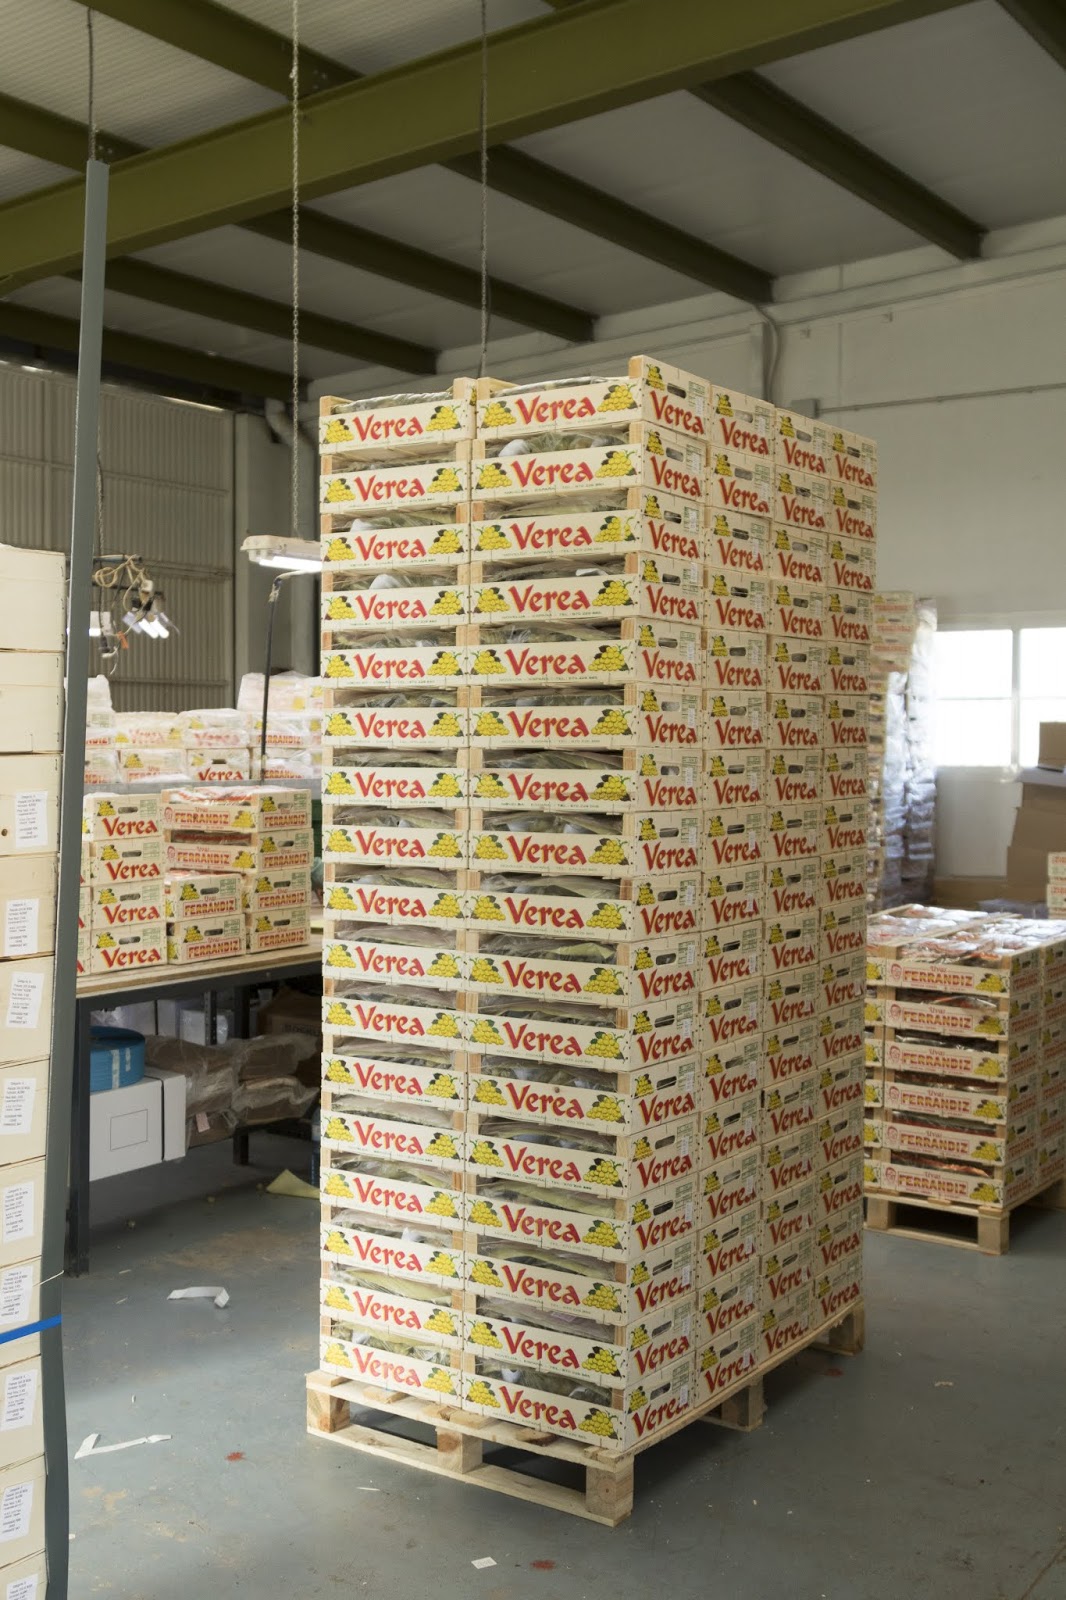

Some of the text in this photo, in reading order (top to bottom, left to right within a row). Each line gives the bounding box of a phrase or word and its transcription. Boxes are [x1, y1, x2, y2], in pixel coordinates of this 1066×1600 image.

[516, 396, 596, 424] Verea
[650, 390, 703, 433] Verea
[353, 415, 423, 441] Verea
[720, 418, 768, 454] Verea
[784, 439, 825, 473] Verea
[835, 454, 873, 486] Verea
[512, 458, 593, 486] Verea
[651, 456, 700, 496] Verea
[354, 475, 425, 501] Verea
[782, 496, 824, 527] Verea
[836, 509, 873, 538] Verea
[354, 535, 427, 561] Verea
[511, 522, 593, 550] Verea
[649, 521, 698, 558] Verea
[718, 539, 763, 571] Verea
[778, 552, 821, 582] Verea
[834, 562, 871, 591] Verea
[355, 593, 427, 620] Verea
[509, 584, 590, 613] Verea
[647, 585, 697, 619] Verea
[716, 599, 764, 628] Verea
[780, 608, 822, 636] Verea
[832, 615, 867, 640] Verea
[354, 653, 426, 679] Verea
[505, 648, 586, 676] Verea
[643, 650, 695, 681] Verea
[715, 660, 761, 686] Verea
[830, 668, 866, 692] Verea
[354, 712, 427, 739] Verea
[508, 710, 589, 738] Verea
[645, 715, 696, 743] Verea
[715, 720, 761, 744] Verea
[831, 721, 865, 743] Verea
[198, 768, 244, 780] Verea
[354, 771, 426, 799] Verea
[508, 773, 589, 802] Verea
[830, 774, 864, 797] Verea
[645, 780, 696, 806] Verea
[775, 777, 816, 800] Verea
[102, 816, 158, 836] Verea
[175, 812, 229, 824] FERRANDIZ
[265, 814, 305, 827] FERRANDIZ
[355, 829, 426, 858] Verea
[508, 835, 586, 865] Verea
[828, 827, 864, 848] Verea
[106, 860, 160, 880] Verea
[177, 852, 230, 864] FERRANDIZ
[264, 854, 307, 866] FERRANDIZ
[643, 844, 696, 870] Verea
[259, 893, 304, 906] FERRANDIZ
[357, 887, 427, 918] Verea
[828, 881, 863, 901] Verea
[102, 904, 160, 924] Verea
[185, 900, 234, 915] FERRANDIZ
[506, 896, 584, 928] Verea
[641, 908, 694, 934] Verea
[189, 941, 238, 958] FERRANDIZ
[259, 931, 304, 946] FERRANDIZ
[827, 932, 862, 953] Verea
[101, 948, 160, 968] Verea
[355, 945, 425, 977] Verea
[772, 945, 814, 968] Verea
[503, 959, 581, 993] Verea
[639, 971, 693, 998] Verea
[904, 970, 972, 986] FERRANDIZ
[355, 1003, 425, 1036] Verea
[903, 1011, 971, 1028] FERRANDIZ
[503, 1020, 583, 1056] Verea
[638, 1034, 692, 1061] Verea
[823, 1034, 861, 1056] Verea
[769, 1056, 811, 1078] Verea
[902, 1052, 971, 1070] FERRANDIZ
[354, 1061, 423, 1096] Verea
[506, 1081, 585, 1119] Verea
[640, 1094, 694, 1124] Verea
[822, 1082, 861, 1109] Verea
[902, 1093, 970, 1112] FERRANDIZ
[352, 1119, 424, 1155] Verea
[823, 1135, 860, 1162] Verea
[901, 1133, 968, 1153] FERRANDIZ
[503, 1143, 582, 1182] Verea
[637, 1155, 691, 1187] Verea
[353, 1176, 423, 1213] Verea
[899, 1174, 966, 1194] FERRANDIZ
[822, 1184, 861, 1213] Verea
[502, 1203, 581, 1244] Verea
[352, 1234, 422, 1272] Verea
[821, 1232, 859, 1264] Verea
[502, 1264, 580, 1306] Verea
[353, 1290, 421, 1329] Verea
[821, 1283, 859, 1316] Verea
[501, 1325, 580, 1369] Verea
[635, 1336, 688, 1374] Verea
[352, 1347, 421, 1387] Verea
[500, 1385, 577, 1430] Verea
